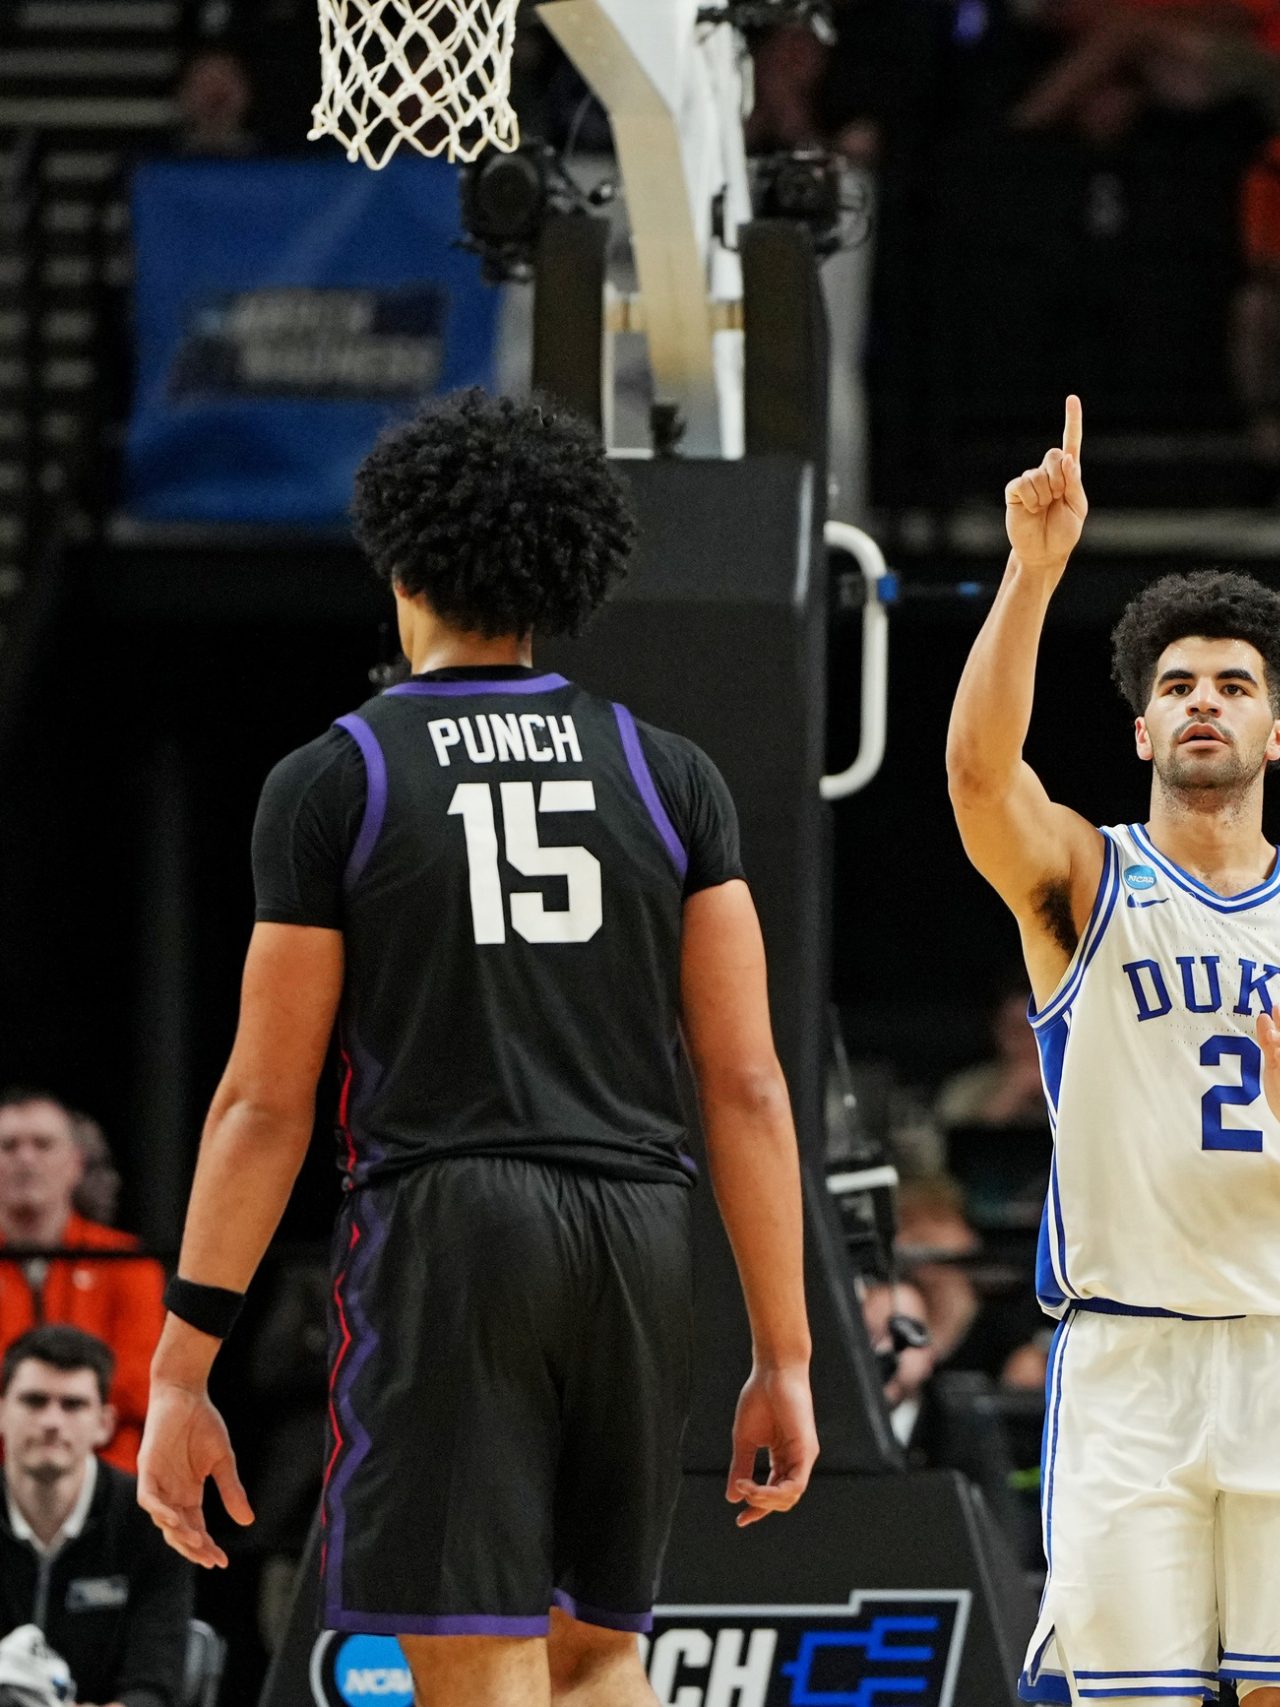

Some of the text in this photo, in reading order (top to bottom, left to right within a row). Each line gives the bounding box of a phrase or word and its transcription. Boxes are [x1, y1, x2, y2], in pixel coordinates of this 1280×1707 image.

[427, 713, 583, 767] PUNCH
[447, 781, 602, 944] 15
[1200, 1035, 1263, 1152] 2
